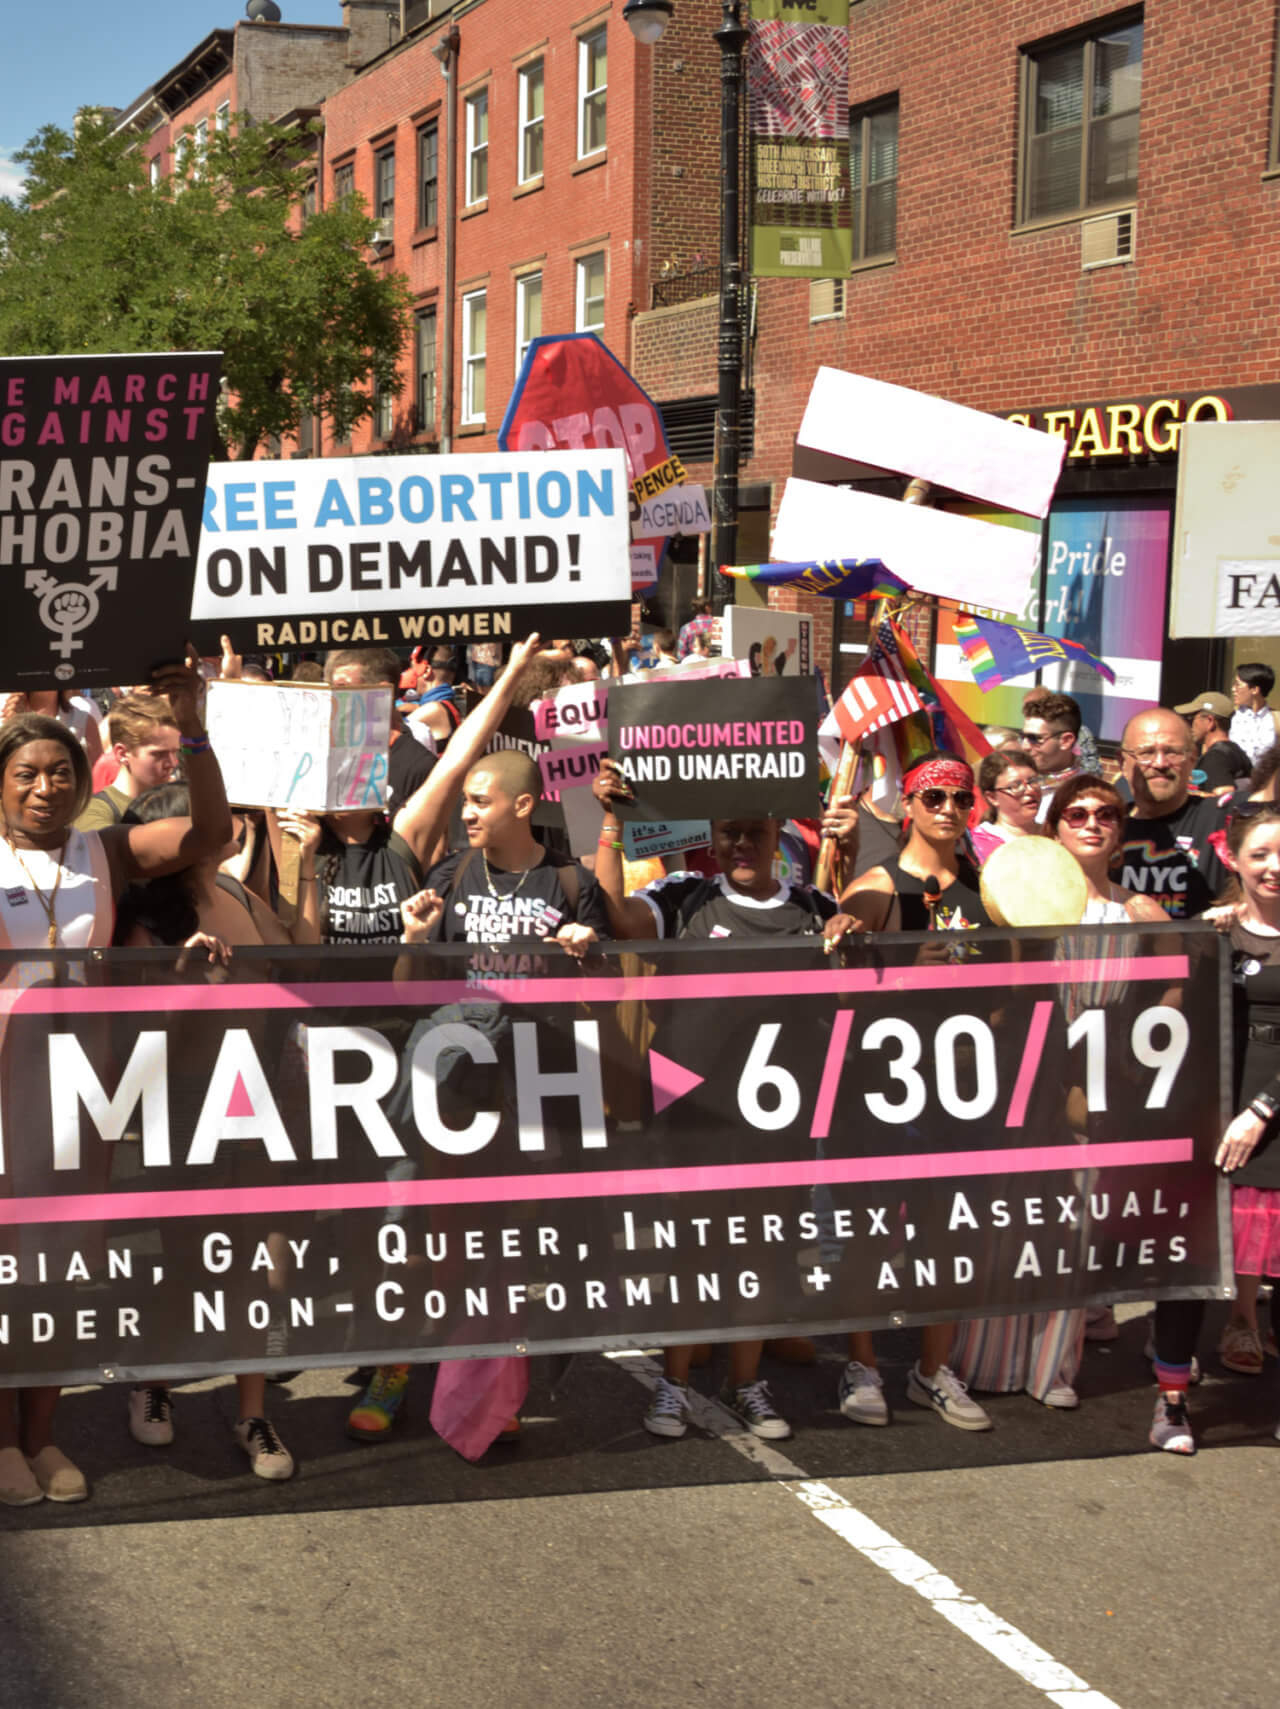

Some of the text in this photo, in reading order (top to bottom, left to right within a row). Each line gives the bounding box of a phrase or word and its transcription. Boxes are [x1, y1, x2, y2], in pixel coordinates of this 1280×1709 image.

[53, 372, 210, 405] MARCH
[634, 459, 685, 498] PENCE
[314, 468, 615, 528] ABORTION
[641, 501, 707, 530] AGENDA
[207, 534, 581, 597] ON DEMAND!
[1048, 537, 1126, 576] Pride
[256, 612, 513, 647] RADICAL WOMEN
[620, 720, 805, 750] UNDOCUMENTED
[622, 752, 806, 782] AND UNAFRAID
[1121, 865, 1188, 892] NYC
[468, 895, 546, 917] TRANS
[464, 913, 549, 937] RIGHTS
[48, 1020, 607, 1171] MARCH
[737, 1000, 1191, 1139] 6/30/19
[202, 1231, 339, 1275] GAY,
[377, 1222, 589, 1266] QUEER,
[623, 1208, 916, 1251] INTERSEX,
[948, 1188, 1190, 1232] ASEXUAL,
[878, 1255, 975, 1291] AND
[1014, 1235, 1188, 1280] ALLIES
